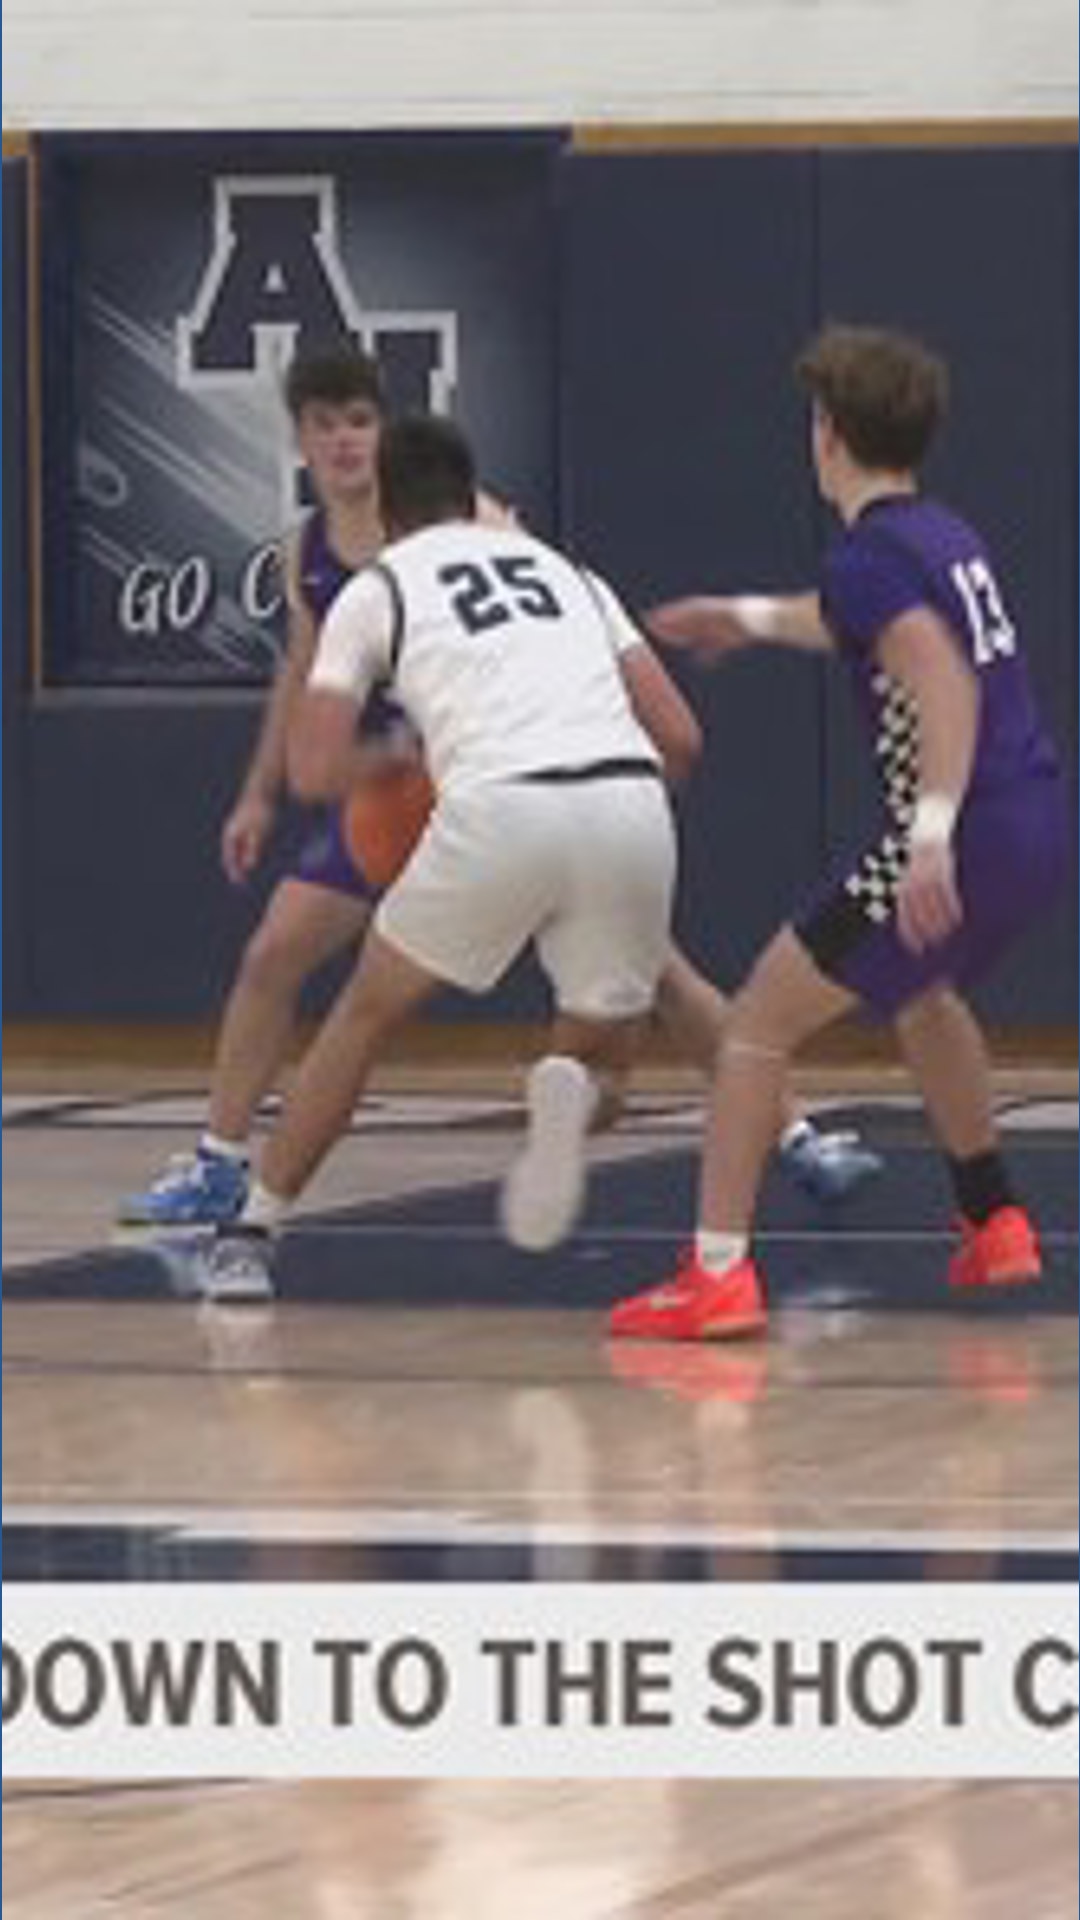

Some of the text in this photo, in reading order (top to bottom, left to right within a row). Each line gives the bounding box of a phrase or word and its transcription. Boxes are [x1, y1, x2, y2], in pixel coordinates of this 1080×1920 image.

[121, 556, 210, 636] GO
[438, 556, 563, 636] 25
[950, 559, 1016, 664] 13
